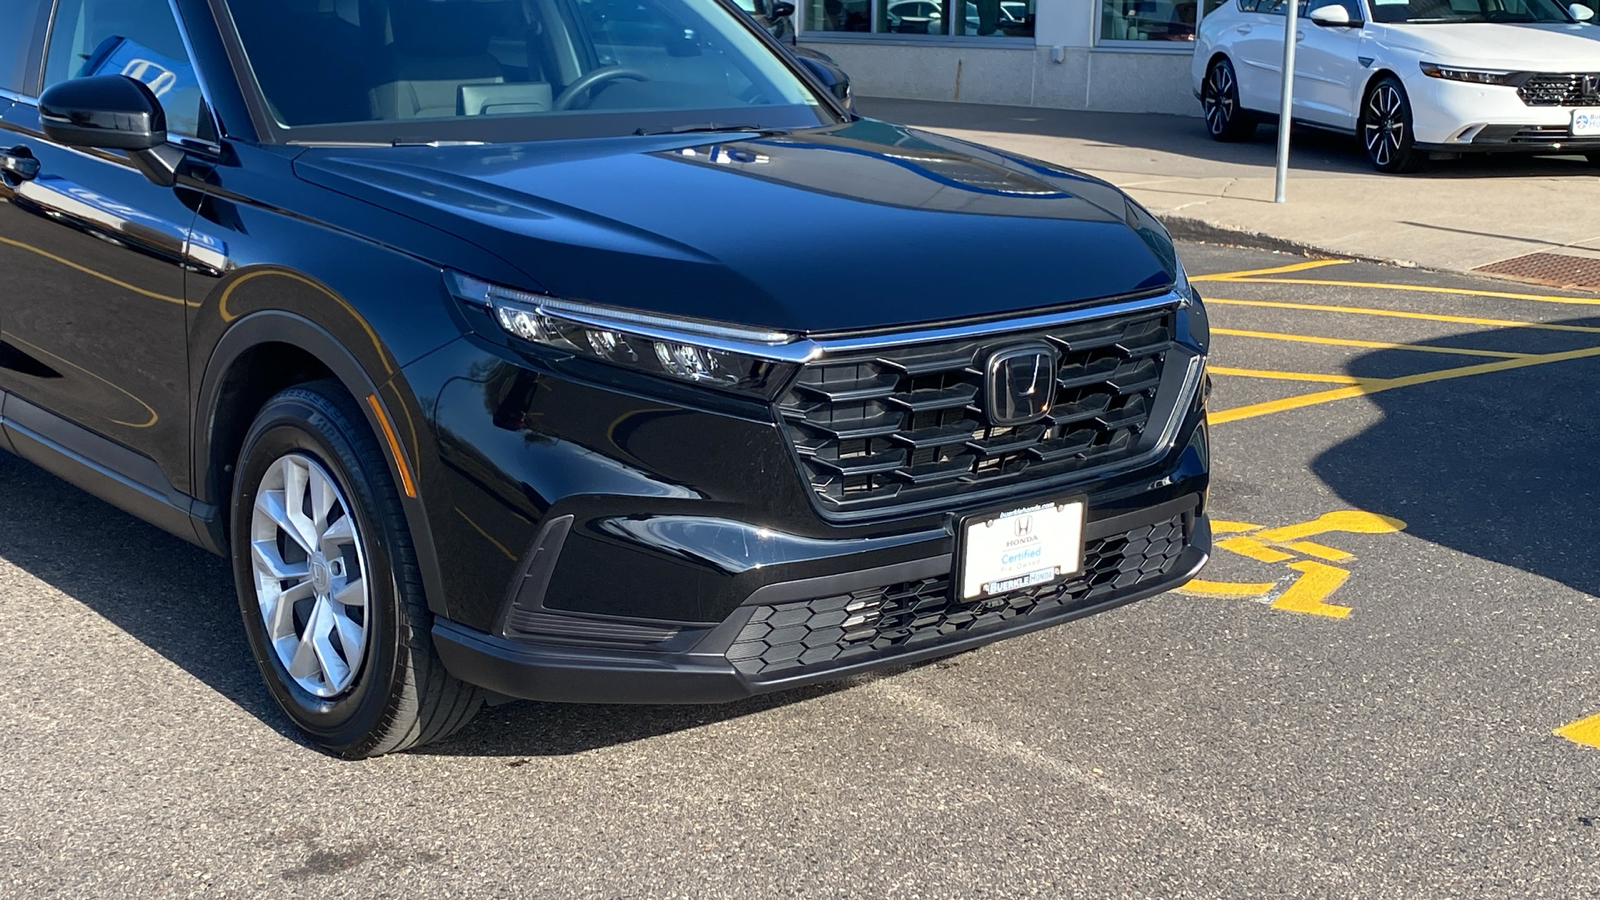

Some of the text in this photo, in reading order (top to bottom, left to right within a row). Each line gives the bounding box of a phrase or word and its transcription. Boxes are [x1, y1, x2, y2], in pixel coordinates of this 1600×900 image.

[1006, 535, 1038, 547] HONDA
[1002, 547, 1041, 564] Certified
[990, 571, 1052, 592] BUERKLE HONDA
